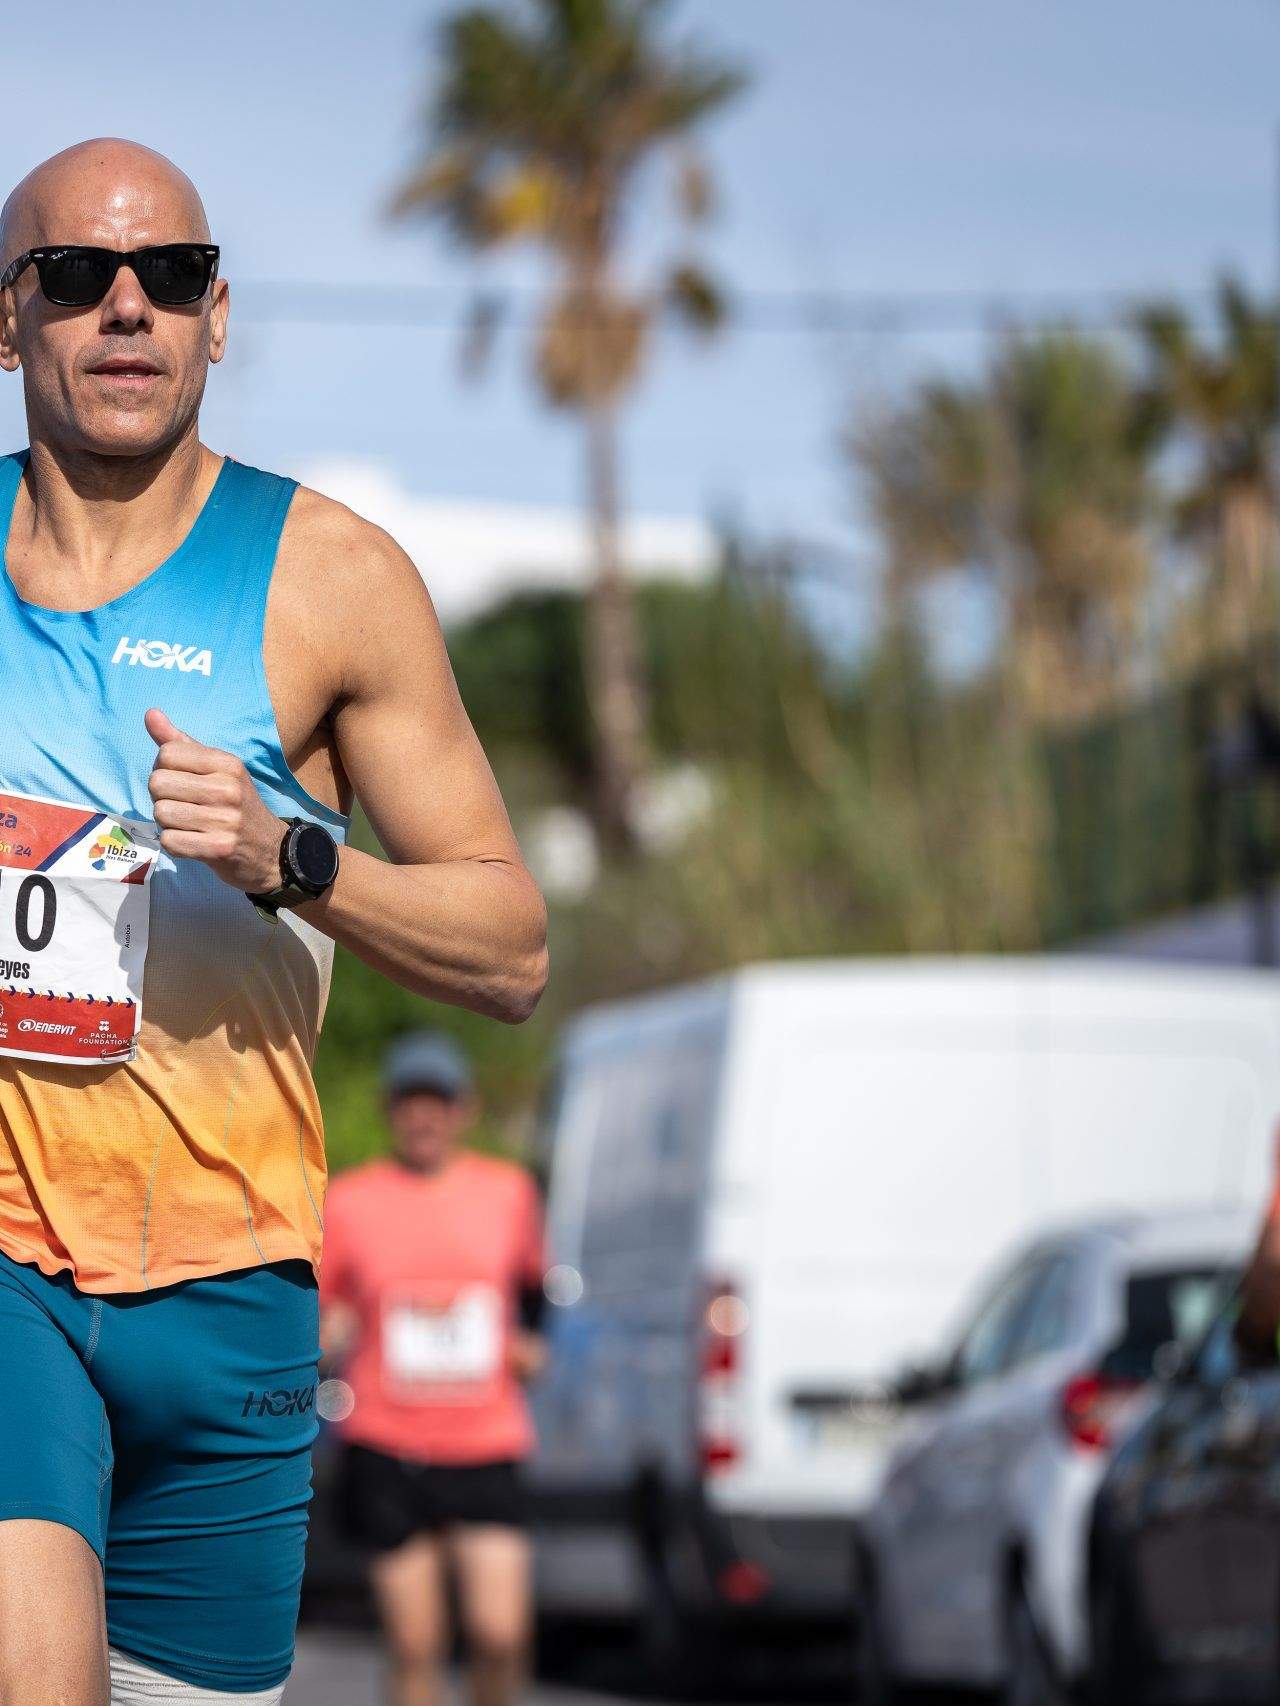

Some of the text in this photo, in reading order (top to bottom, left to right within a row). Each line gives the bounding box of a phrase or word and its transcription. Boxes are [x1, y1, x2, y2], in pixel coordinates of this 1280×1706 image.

[111, 636, 212, 676] HOKA
[107, 844, 138, 859] Ibiza
[34, 1022, 77, 1036] ENERVIT
[240, 1384, 316, 1418] HOKA
